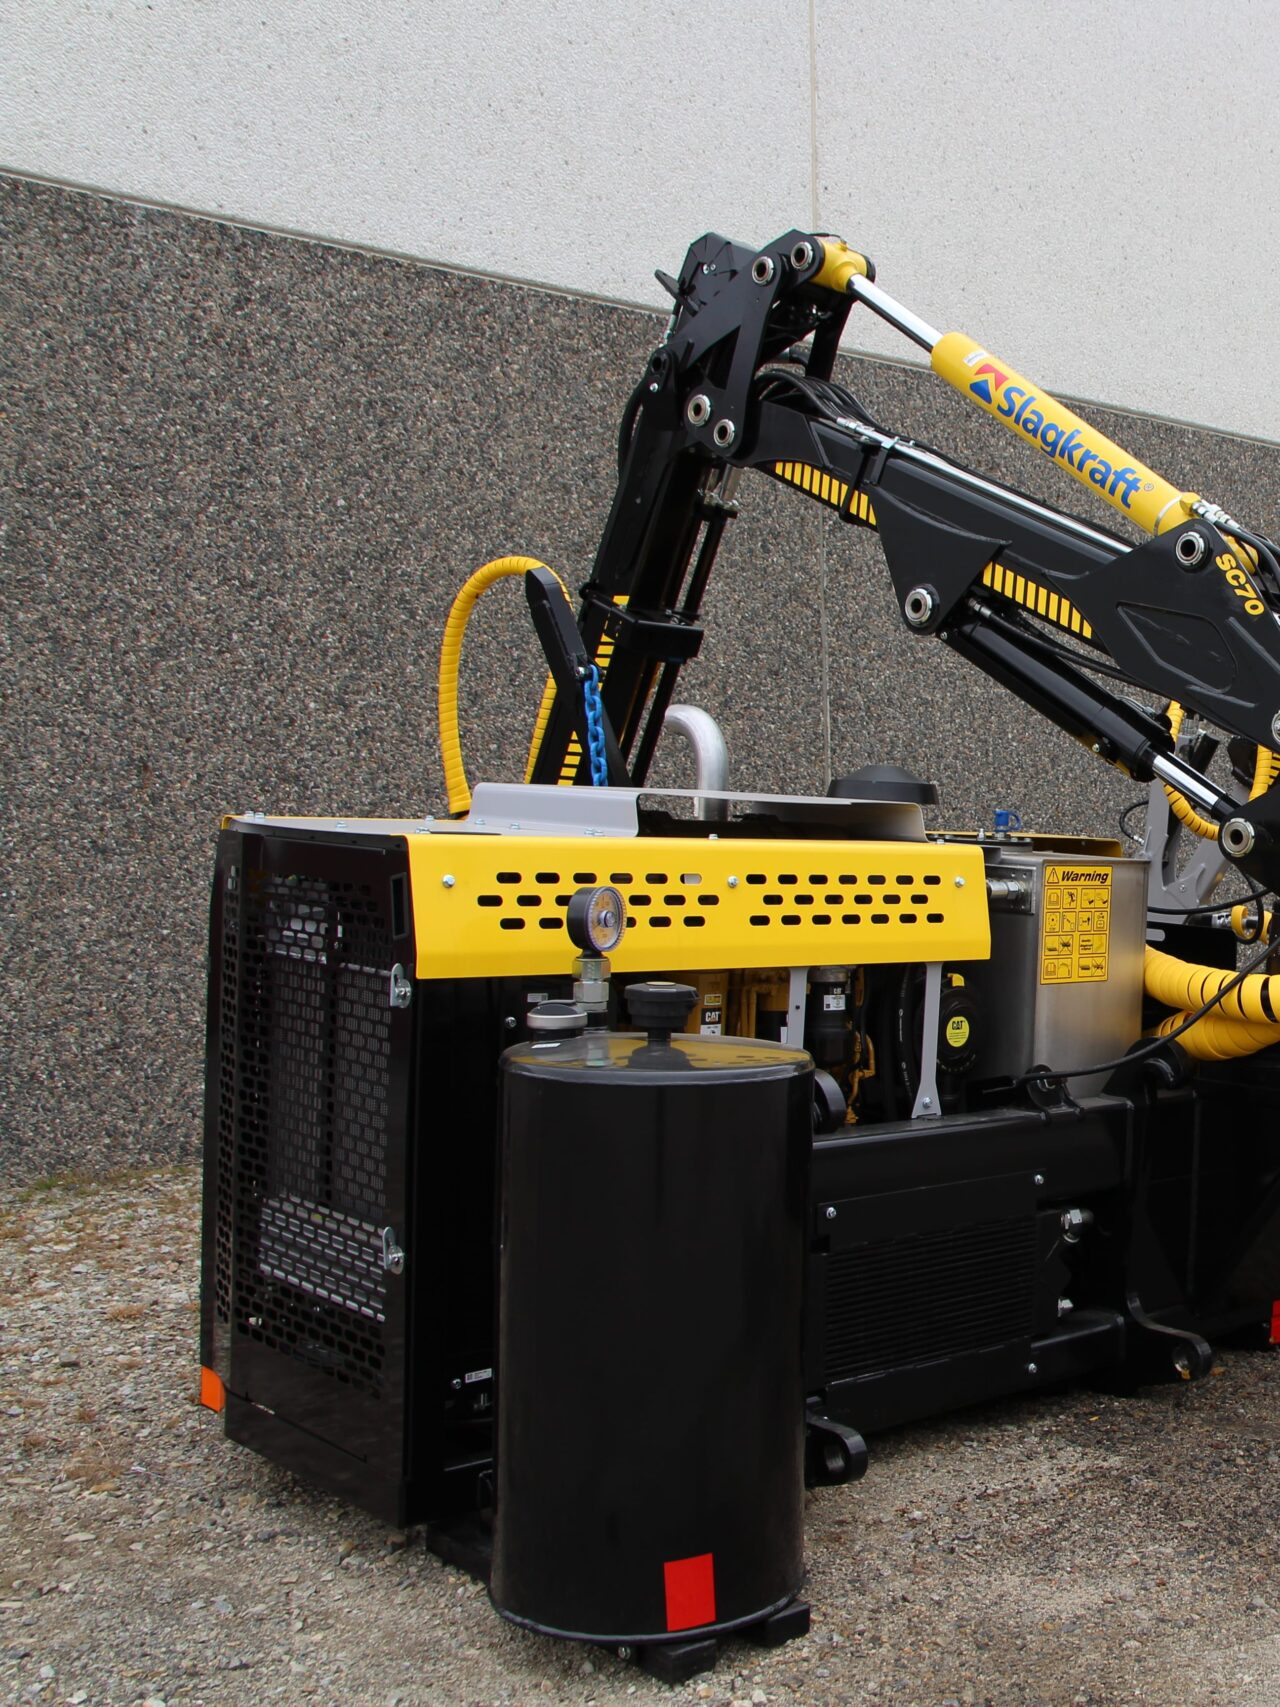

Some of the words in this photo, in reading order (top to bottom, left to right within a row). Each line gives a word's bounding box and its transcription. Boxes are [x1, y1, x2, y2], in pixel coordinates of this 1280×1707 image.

[997, 386, 1143, 509] Slagkraft
[1214, 552, 1266, 616] SC70
[1061, 871, 1109, 884] Warning
[705, 1011, 720, 1023] CAT
[951, 1020, 963, 1031] CAT
